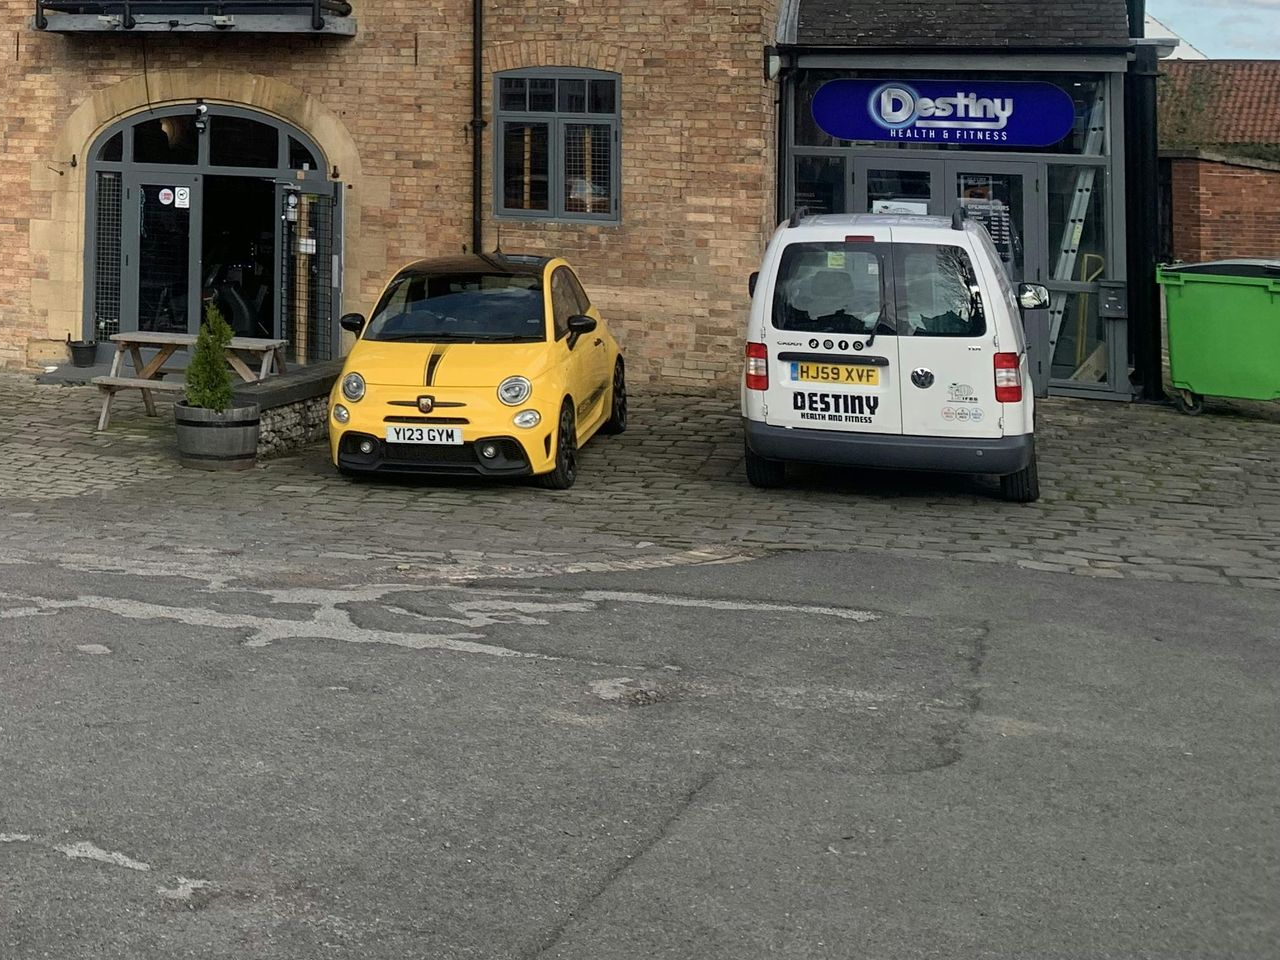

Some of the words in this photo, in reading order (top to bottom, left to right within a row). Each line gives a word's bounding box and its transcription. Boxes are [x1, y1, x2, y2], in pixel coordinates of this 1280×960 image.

[881, 88, 1014, 129] Destiny
[890, 129, 936, 139] HEALTH
[943, 130, 949, 139] &
[956, 130, 1008, 141] FITNESS
[800, 365, 840, 380] HJ59
[845, 368, 876, 383] XVF
[793, 391, 879, 416] DESTINY
[801, 412, 826, 421] HEALTH
[828, 414, 843, 422] AND
[845, 415, 873, 424] FITNESS
[394, 427, 424, 441] Y123
[427, 428, 455, 442] GYM
